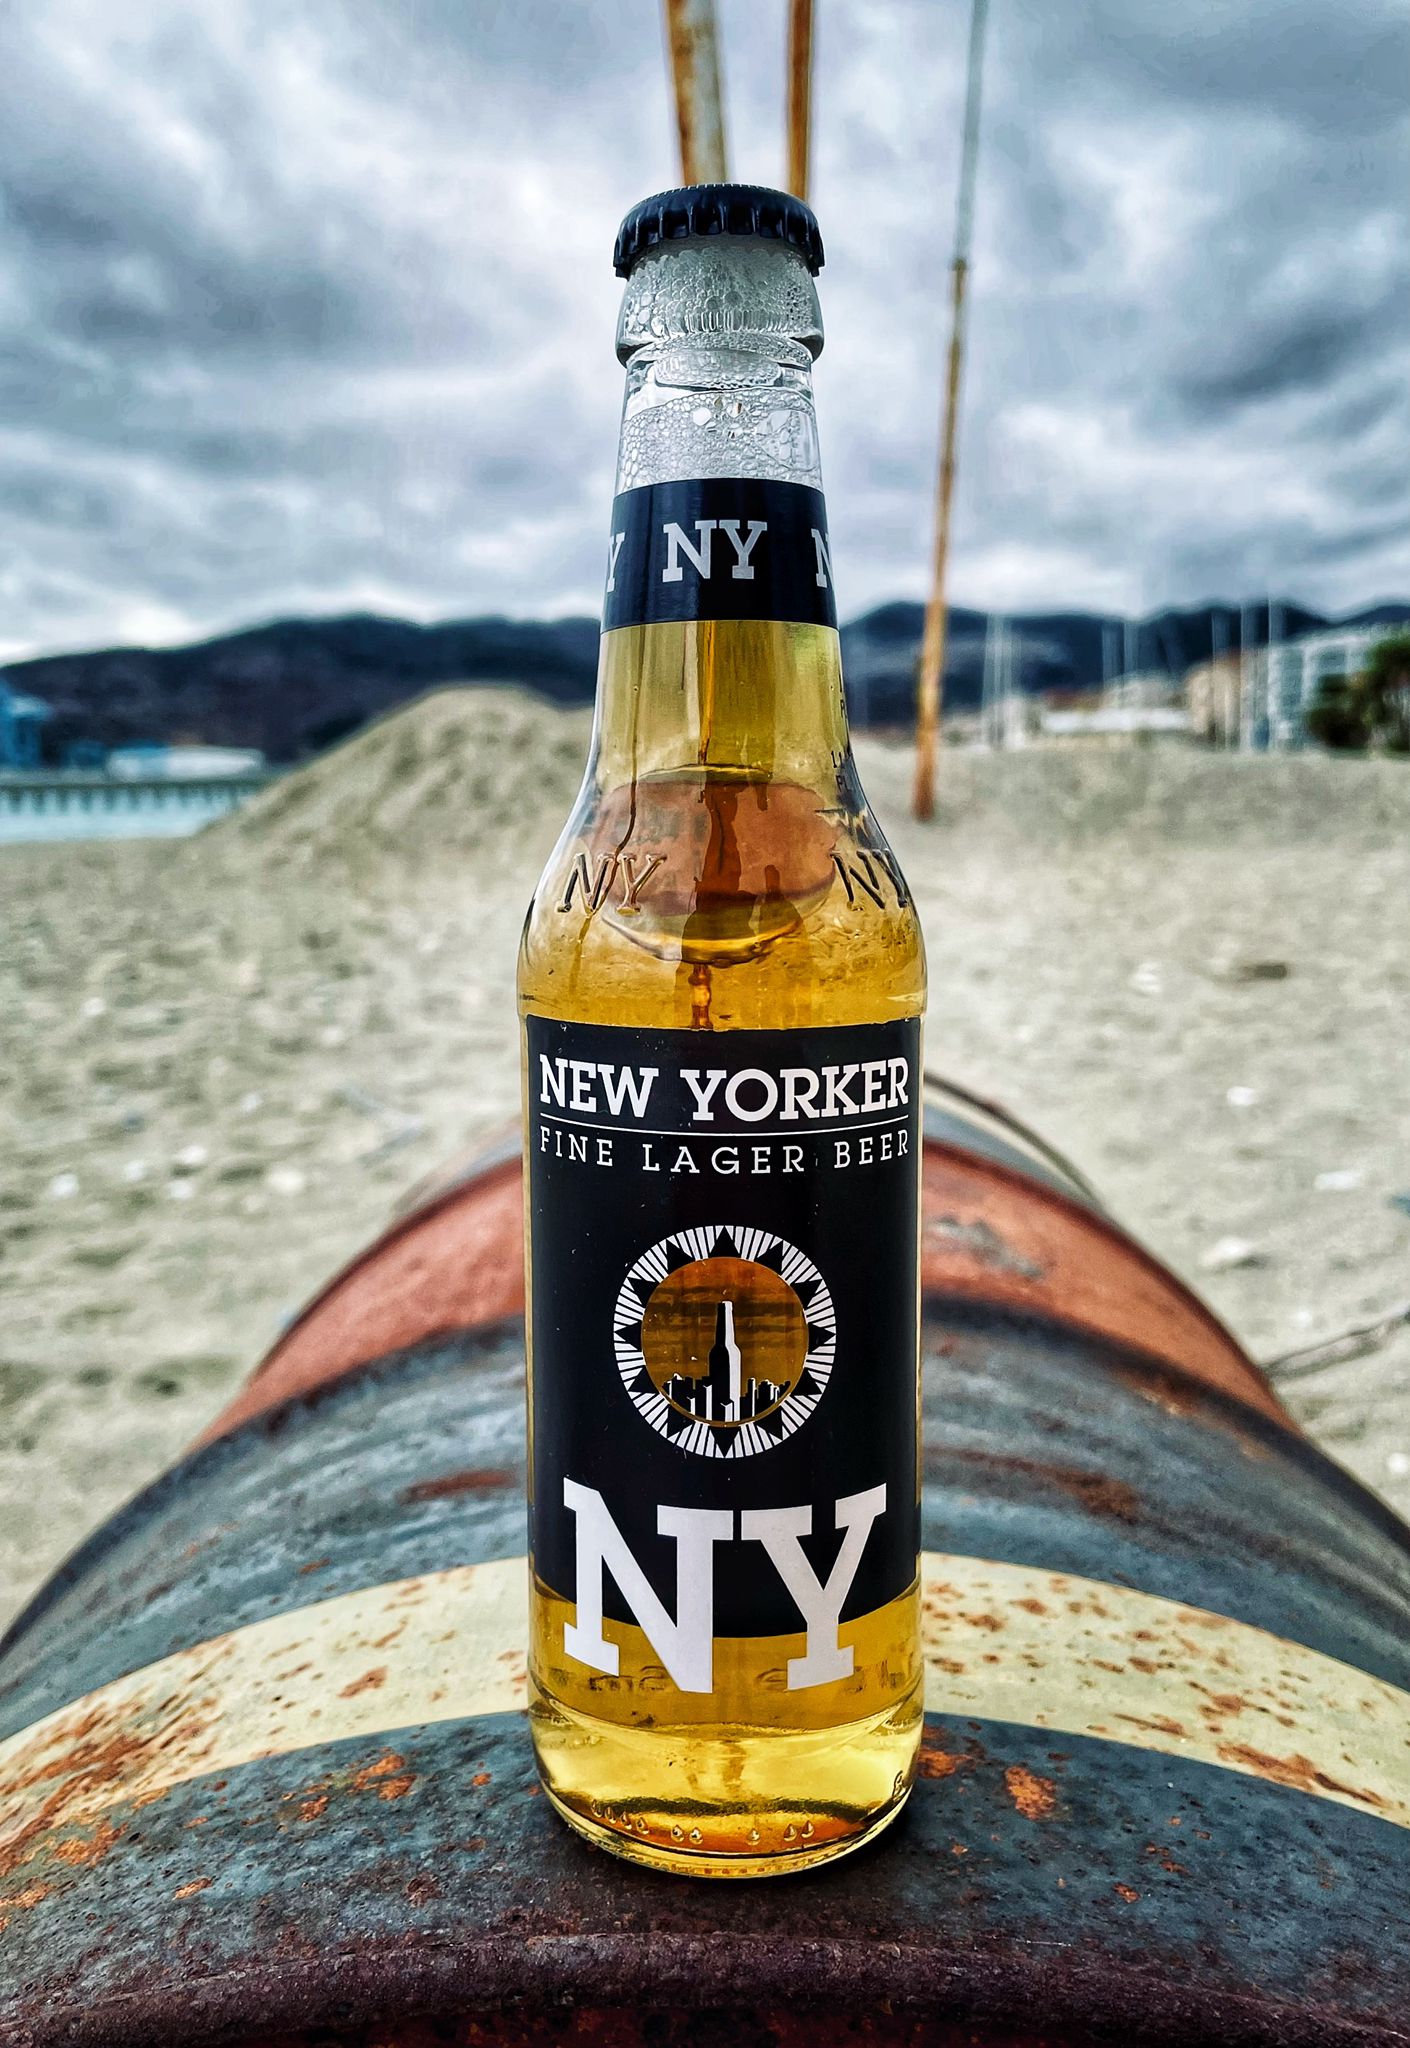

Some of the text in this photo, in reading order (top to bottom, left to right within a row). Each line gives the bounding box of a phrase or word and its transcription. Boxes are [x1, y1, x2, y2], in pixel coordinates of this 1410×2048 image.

[662, 519, 768, 583] NY
[555, 852, 667, 914] NY
[539, 1053, 909, 1122] NEW YORKER
[540, 1125, 909, 1174] FINE LAGER BEER
[563, 1477, 887, 1694] NY
